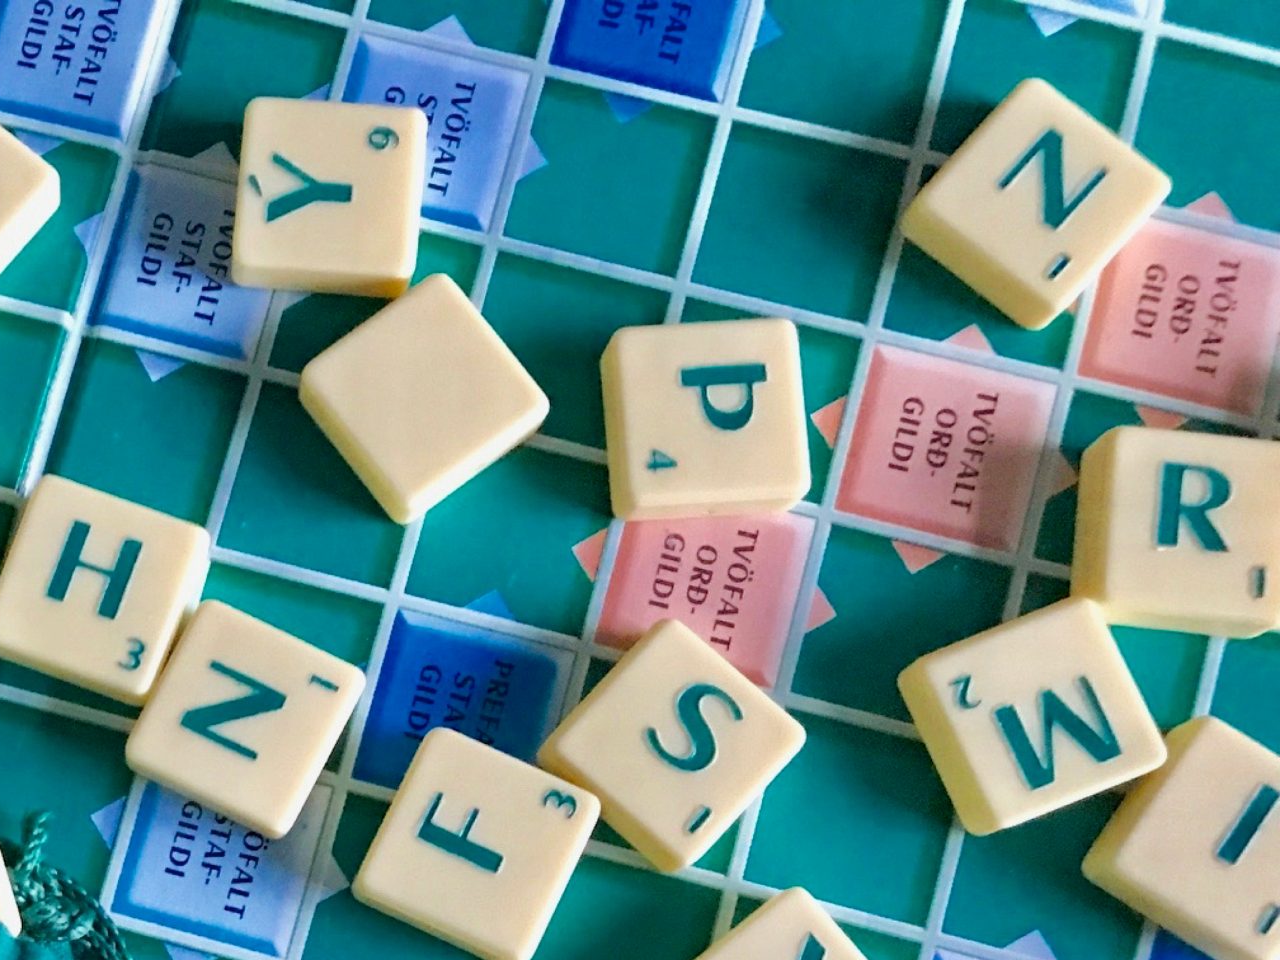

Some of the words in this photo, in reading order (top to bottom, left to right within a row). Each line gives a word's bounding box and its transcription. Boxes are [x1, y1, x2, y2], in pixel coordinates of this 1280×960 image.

[17, 0, 54, 69] GILDI
[52, 4, 86, 76] STAF-
[427, 83, 477, 196] TVÖFALT
[998, 127, 1108, 231] N
[137, 213, 174, 286] GILDI
[172, 220, 206, 293] STAF-
[1132, 264, 1167, 338] GILDI
[888, 397, 924, 472] GILDI
[950, 393, 999, 513] TVÖFALT
[1156, 462, 1233, 553] R
[45, 520, 144, 620] H
[648, 533, 685, 609] GILDI
[710, 530, 759, 651] TVÖFALT
[179, 660, 287, 761] N
[443, 672, 476, 723] STA
[646, 683, 744, 773] S
[164, 801, 203, 877] GILDI
[417, 792, 505, 874] F
[224, 830, 270, 920] ÖFALT
